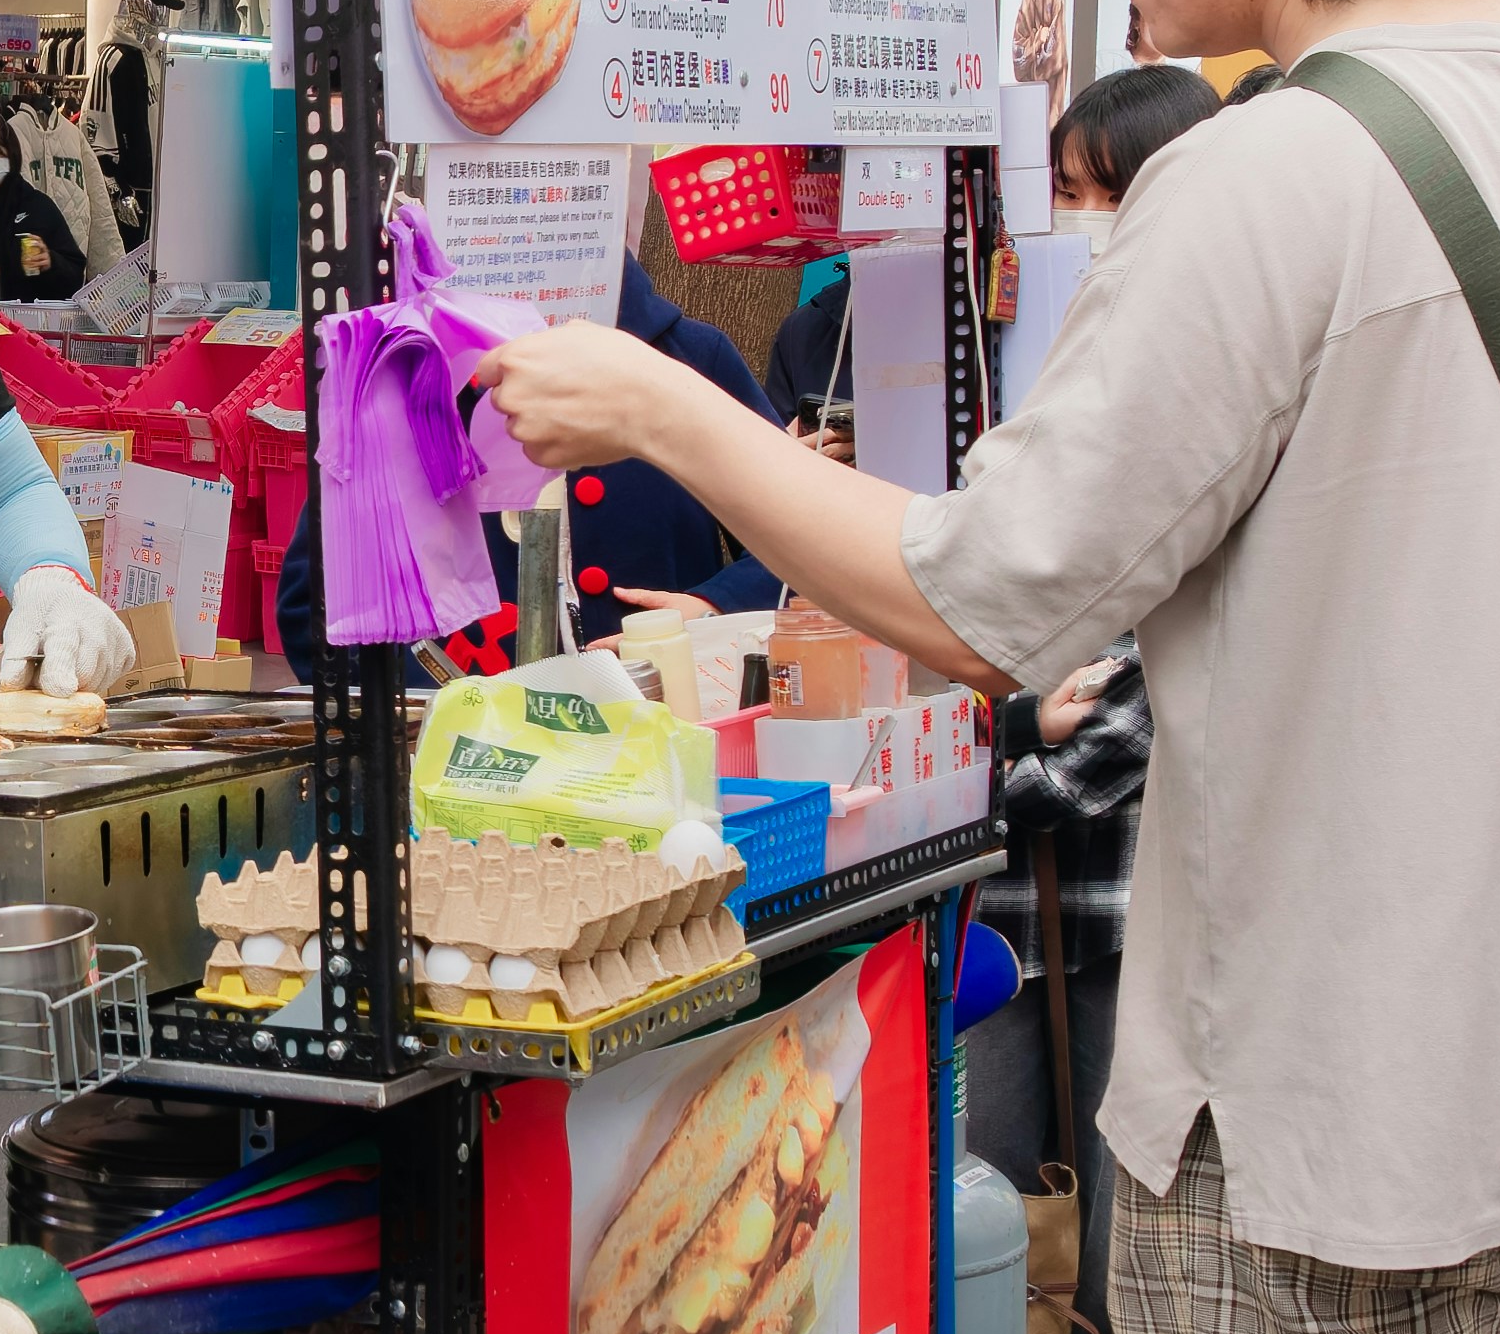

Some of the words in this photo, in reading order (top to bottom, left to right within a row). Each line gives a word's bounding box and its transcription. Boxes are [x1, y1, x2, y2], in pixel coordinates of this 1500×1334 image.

[631, 2, 647, 29] Ham
[648, 3, 662, 30] and
[662, 5, 689, 32] Cheese
[690, 6, 704, 39] Egg
[704, 7, 728, 40] Burger
[6, 39, 32, 52] 690
[955, 53, 982, 90] 150
[770, 73, 790, 114] 90
[633, 97, 648, 123] Pork
[657, 97, 683, 124] Chicken
[684, 98, 706, 124] Cheese
[720, 99, 741, 131] Burger
[858, 190, 887, 207] Double
[890, 190, 905, 208] Egg
[924, 189, 933, 204] 15
[454, 215, 471, 229] your
[472, 214, 489, 225] meal
[490, 213, 518, 225] includes
[539, 212, 560, 226] please
[581, 211, 596, 222] know
[446, 234, 468, 250] prefer
[470, 232, 497, 246] chicken
[537, 231, 556, 244] Thank
[245, 328, 283, 344] 59
